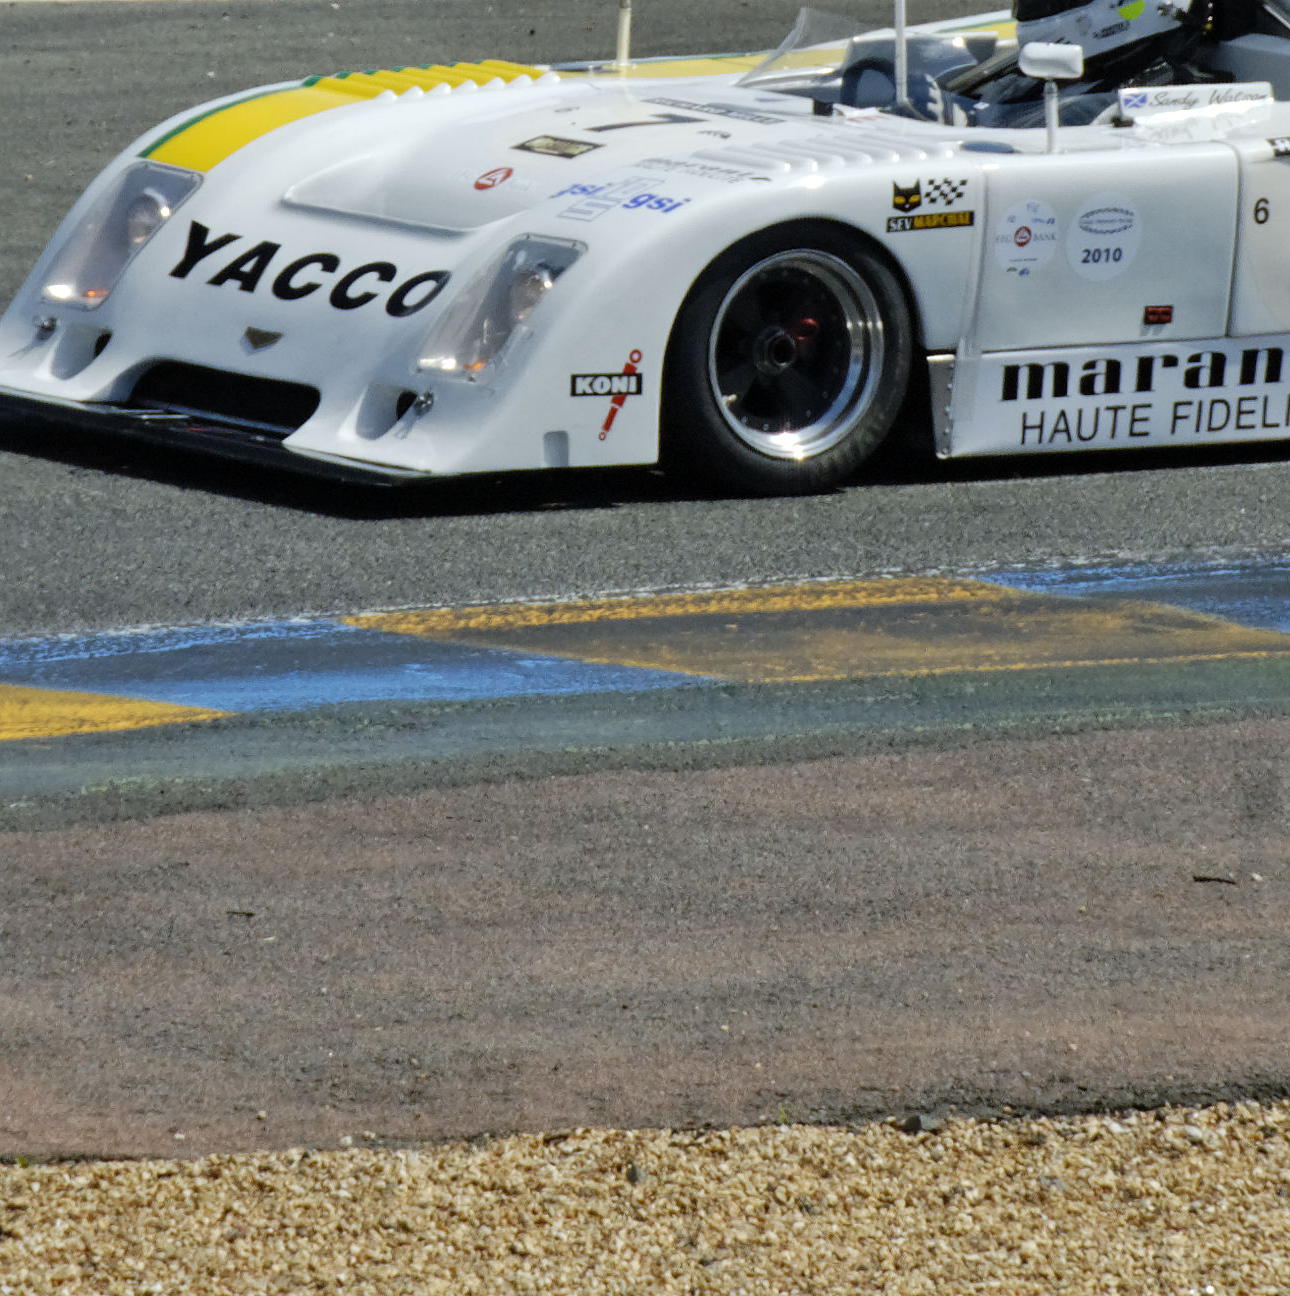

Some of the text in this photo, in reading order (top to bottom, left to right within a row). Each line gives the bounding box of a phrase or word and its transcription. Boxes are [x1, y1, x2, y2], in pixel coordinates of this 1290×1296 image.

[620, 192, 692, 213] gsi
[1253, 198, 1270, 224] 6
[1081, 247, 1123, 264] 2010
[169, 220, 451, 317] YACCO
[575, 375, 638, 395] KONI
[1020, 404, 1153, 445] HAUTE
